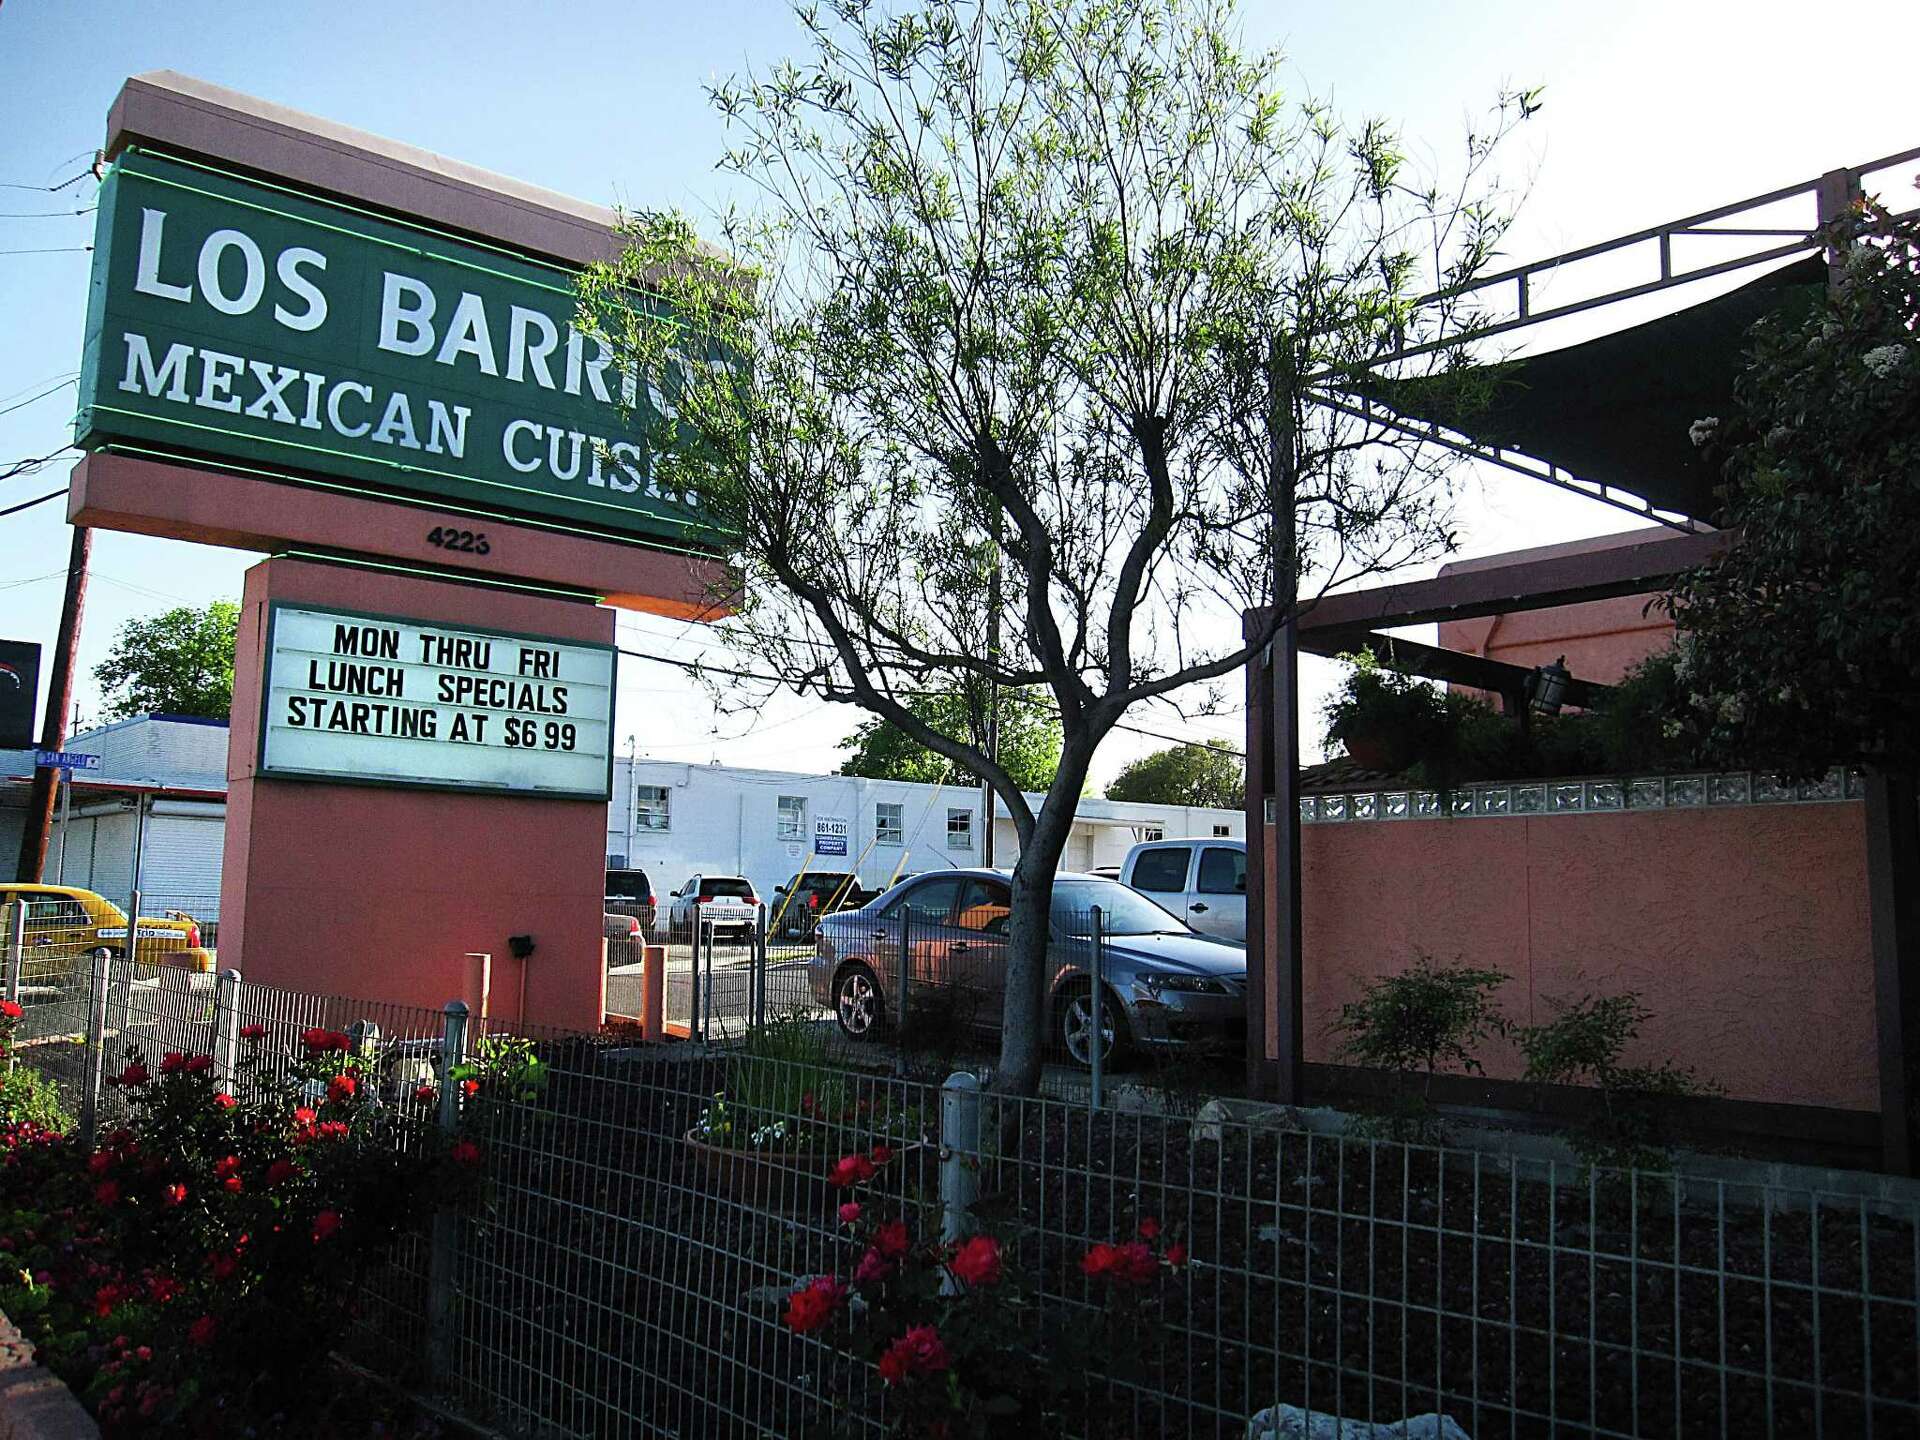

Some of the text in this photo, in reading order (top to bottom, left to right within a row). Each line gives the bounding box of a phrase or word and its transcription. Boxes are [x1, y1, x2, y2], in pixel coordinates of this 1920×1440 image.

[134, 207, 328, 331] LOS
[118, 332, 472, 459] MEXICAN
[333, 624, 560, 678] MON THRU FRI
[309, 659, 568, 714] LUNCH SPECIALS
[287, 696, 437, 739] STARTING
[450, 712, 488, 742] AT
